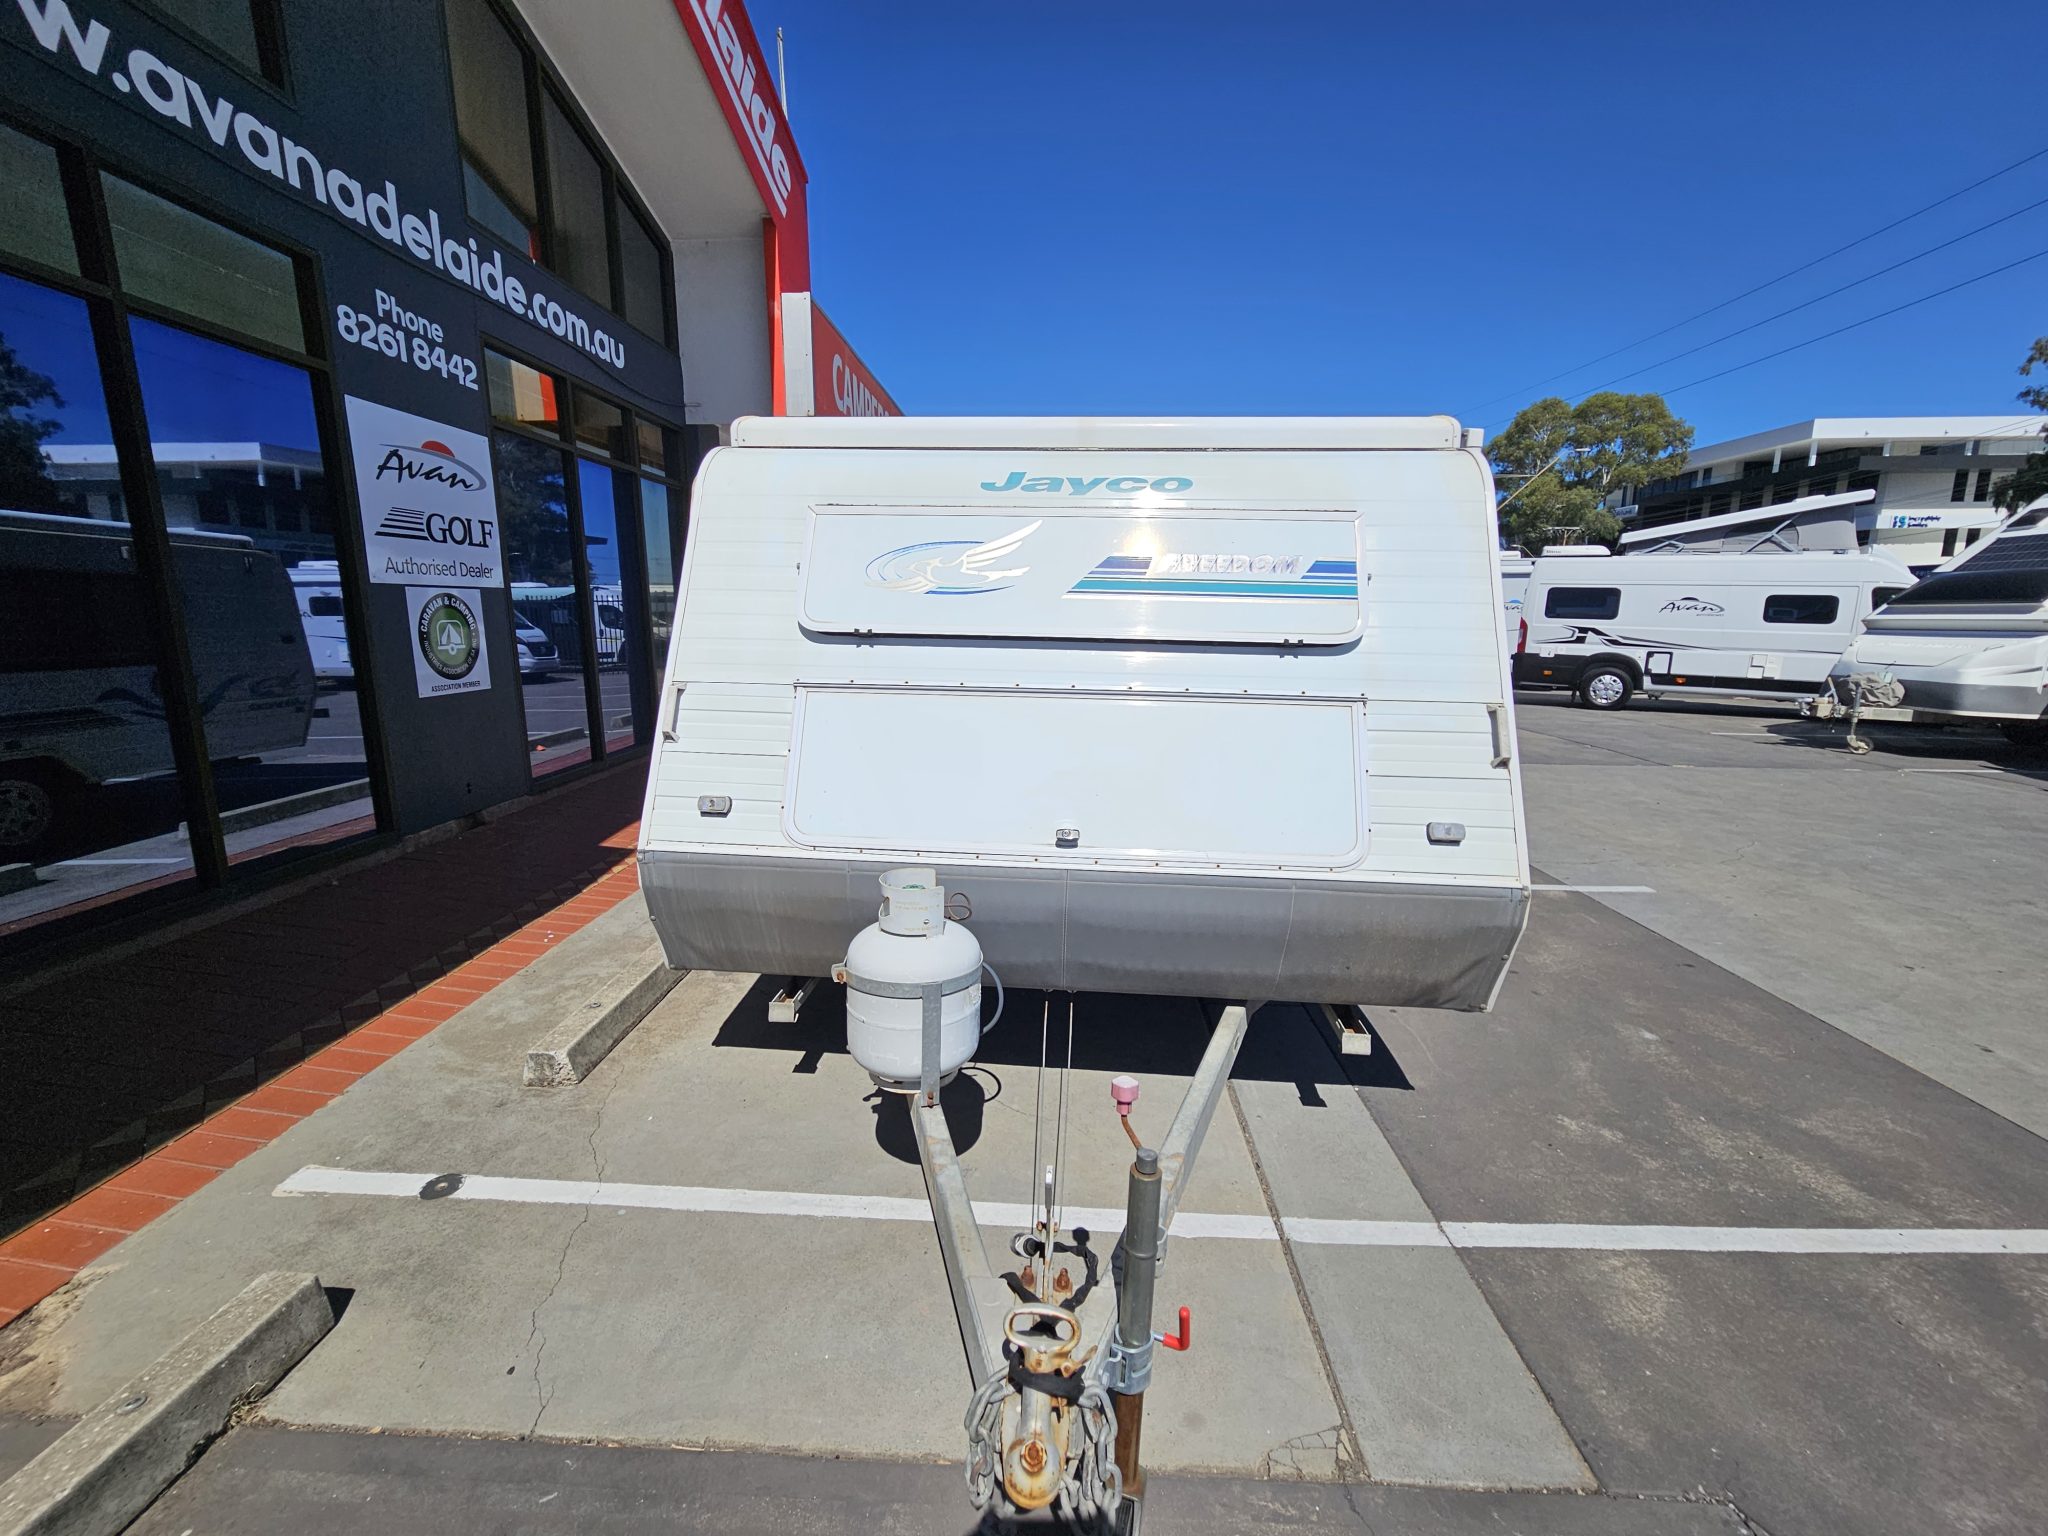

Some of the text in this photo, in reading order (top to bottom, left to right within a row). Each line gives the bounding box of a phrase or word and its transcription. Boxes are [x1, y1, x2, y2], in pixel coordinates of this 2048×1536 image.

[375, 289, 444, 343] Phone
[337, 304, 479, 390] 8261 8442
[376, 449, 474, 488] Avan
[980, 471, 1194, 496] Jayco
[425, 513, 494, 548] GOLF
[385, 557, 494, 579] Authorised Dealer
[420, 596, 477, 632] CARAVAN & CAMPING
[1658, 602, 1717, 613] Avan
[431, 680, 481, 692] ASSOCIATION MEMBER
